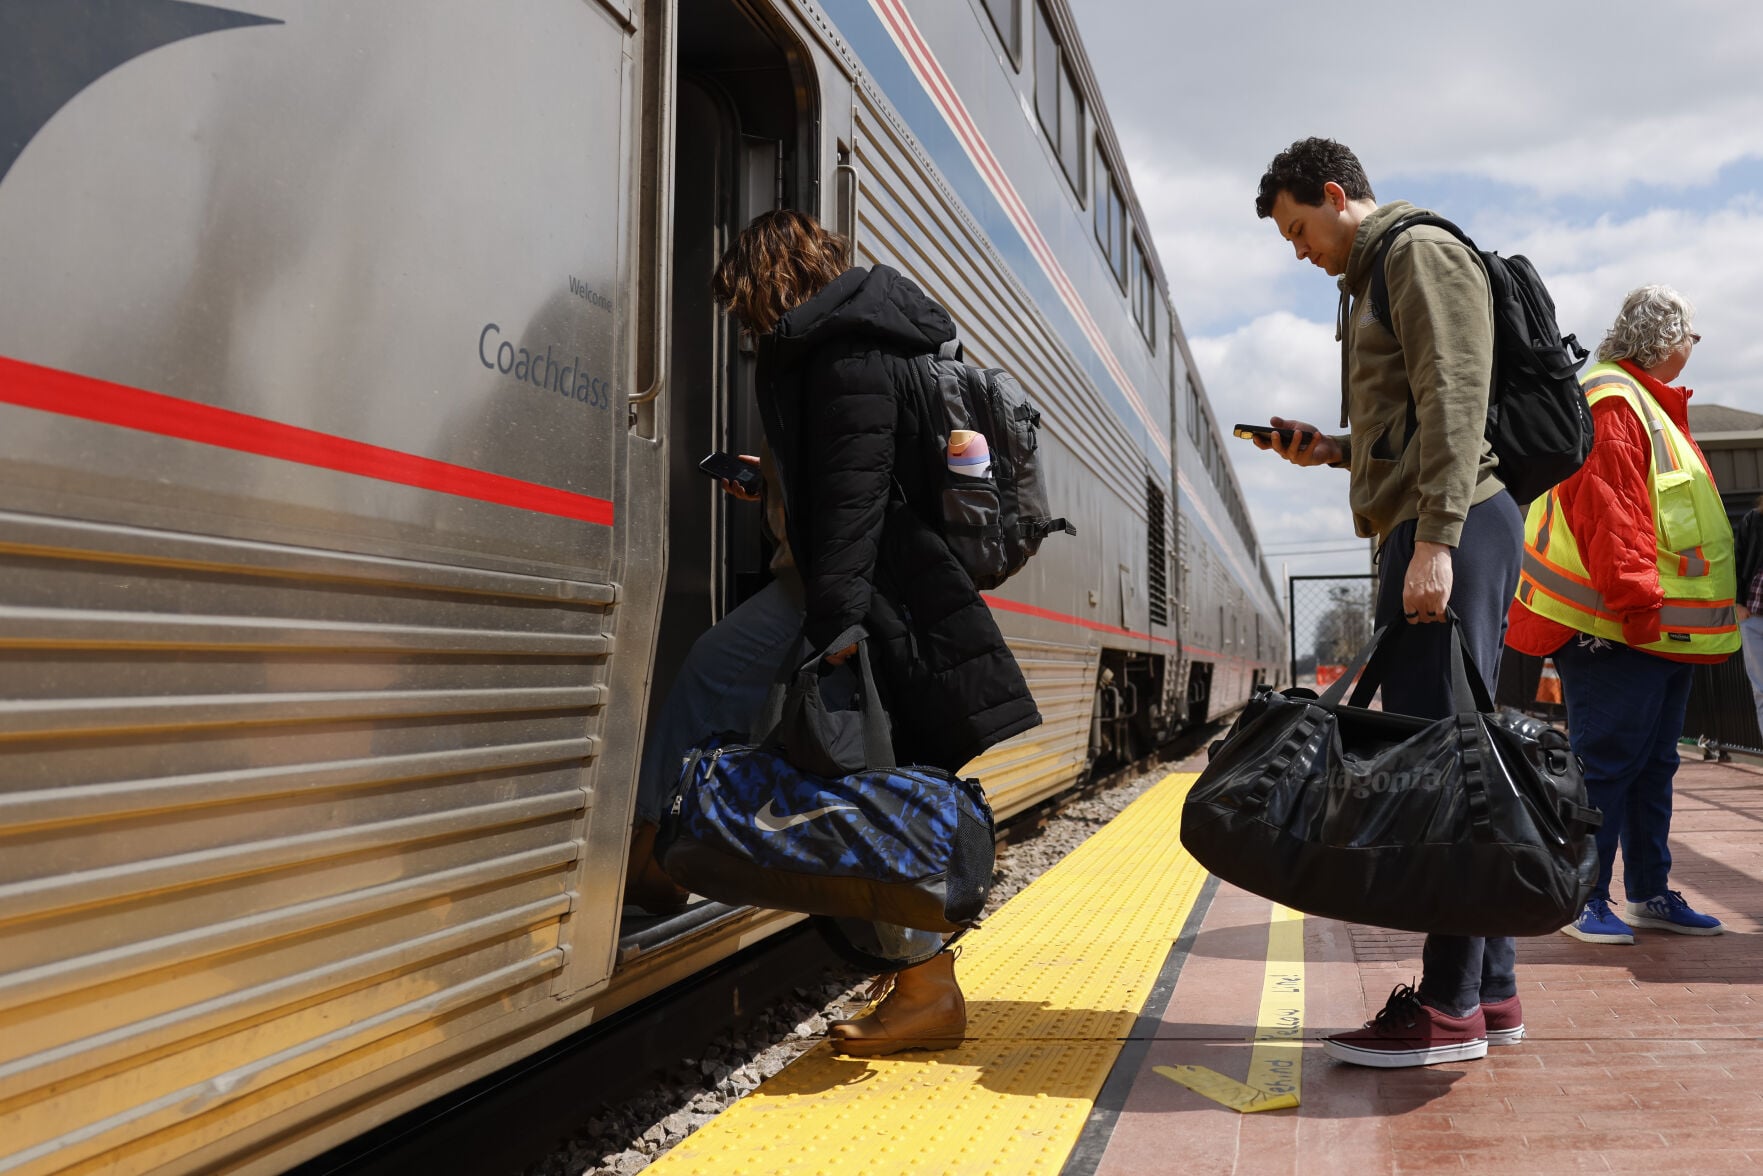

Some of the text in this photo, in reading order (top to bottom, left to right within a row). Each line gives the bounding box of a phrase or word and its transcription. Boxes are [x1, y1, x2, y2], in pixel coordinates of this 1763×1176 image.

[569, 274, 612, 312] Welcome
[479, 323, 609, 410] Coachclass
[1327, 767, 1443, 799] tagonia
[1262, 1060, 1296, 1093] ehind
